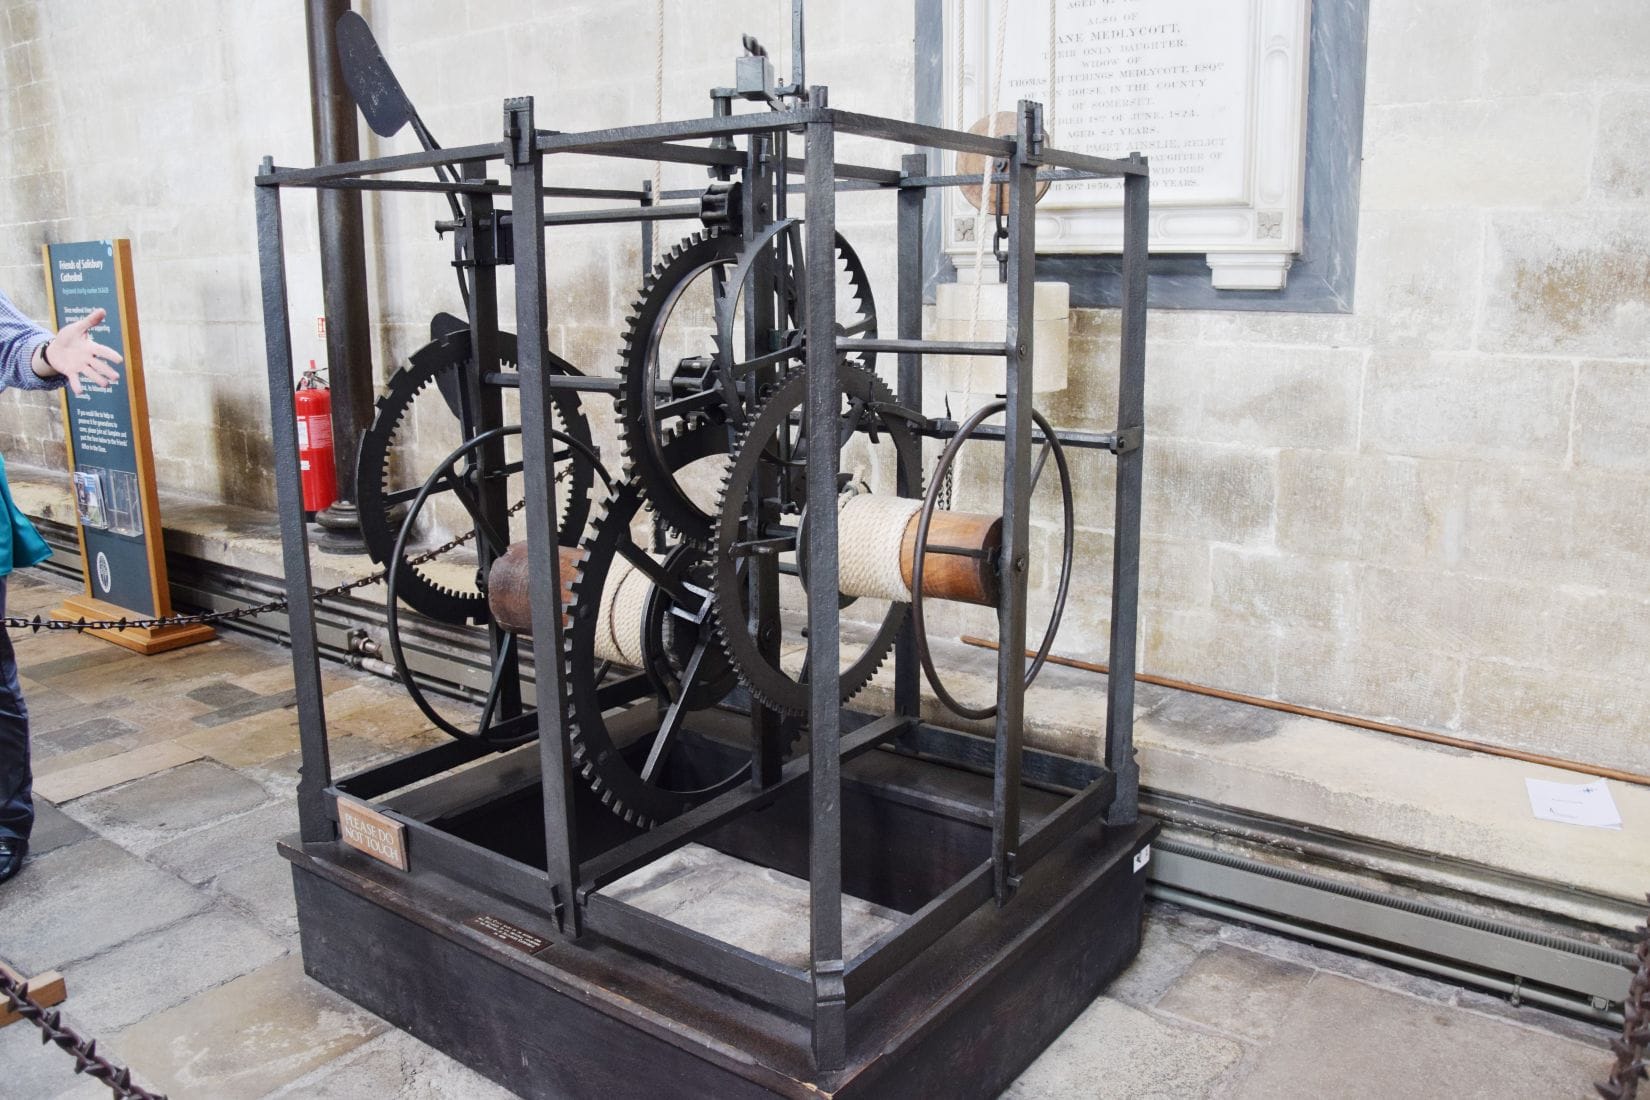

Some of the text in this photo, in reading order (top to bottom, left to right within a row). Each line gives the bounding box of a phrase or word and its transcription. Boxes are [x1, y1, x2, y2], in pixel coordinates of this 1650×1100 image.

[1053, 32, 1084, 44] ANE
[1041, 49, 1077, 60] TEIR
[1083, 46, 1113, 55] ONLY
[1082, 56, 1142, 68] WIDOW OF
[1009, 77, 1047, 89] THOMAS
[1110, 85, 1121, 94] IN
[1128, 83, 1150, 92] THE
[1156, 79, 1208, 90] COUNTY
[1067, 130, 1095, 139] AGED
[1209, 151, 1224, 160] OF
[1152, 165, 1205, 175] WHO DIED
[59, 260, 76, 270] Friends
[81, 258, 103, 270] Salisbury
[60, 272, 83, 282] Cathedral
[345, 813, 394, 845] PLEASE DO
[345, 826, 398, 860] NOT TOUCH
